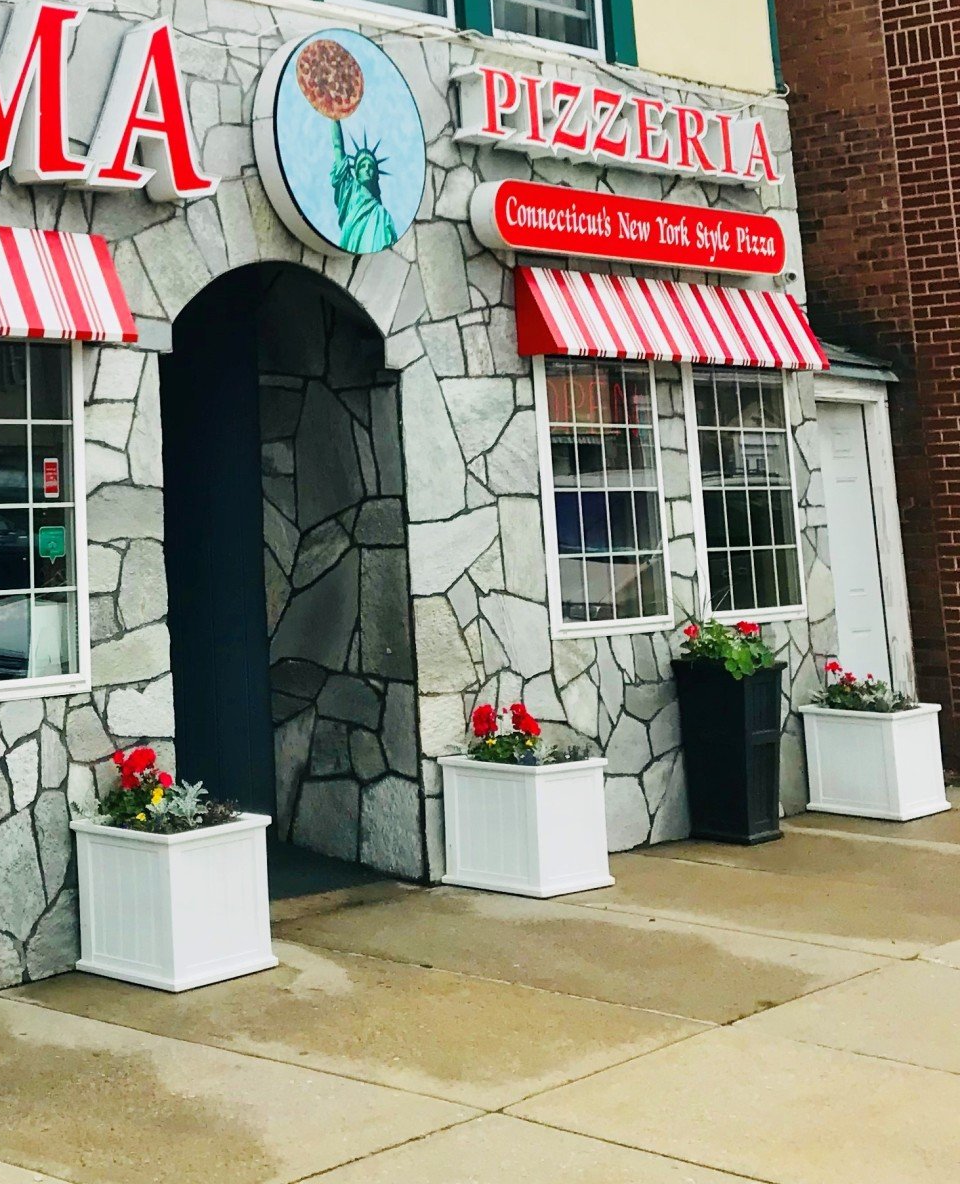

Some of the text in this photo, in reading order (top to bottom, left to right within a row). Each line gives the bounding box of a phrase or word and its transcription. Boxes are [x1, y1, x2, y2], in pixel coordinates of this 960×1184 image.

[478, 65, 785, 185] PIZZERIA
[505, 195, 777, 263] Connecticut's New York Style Pizza
